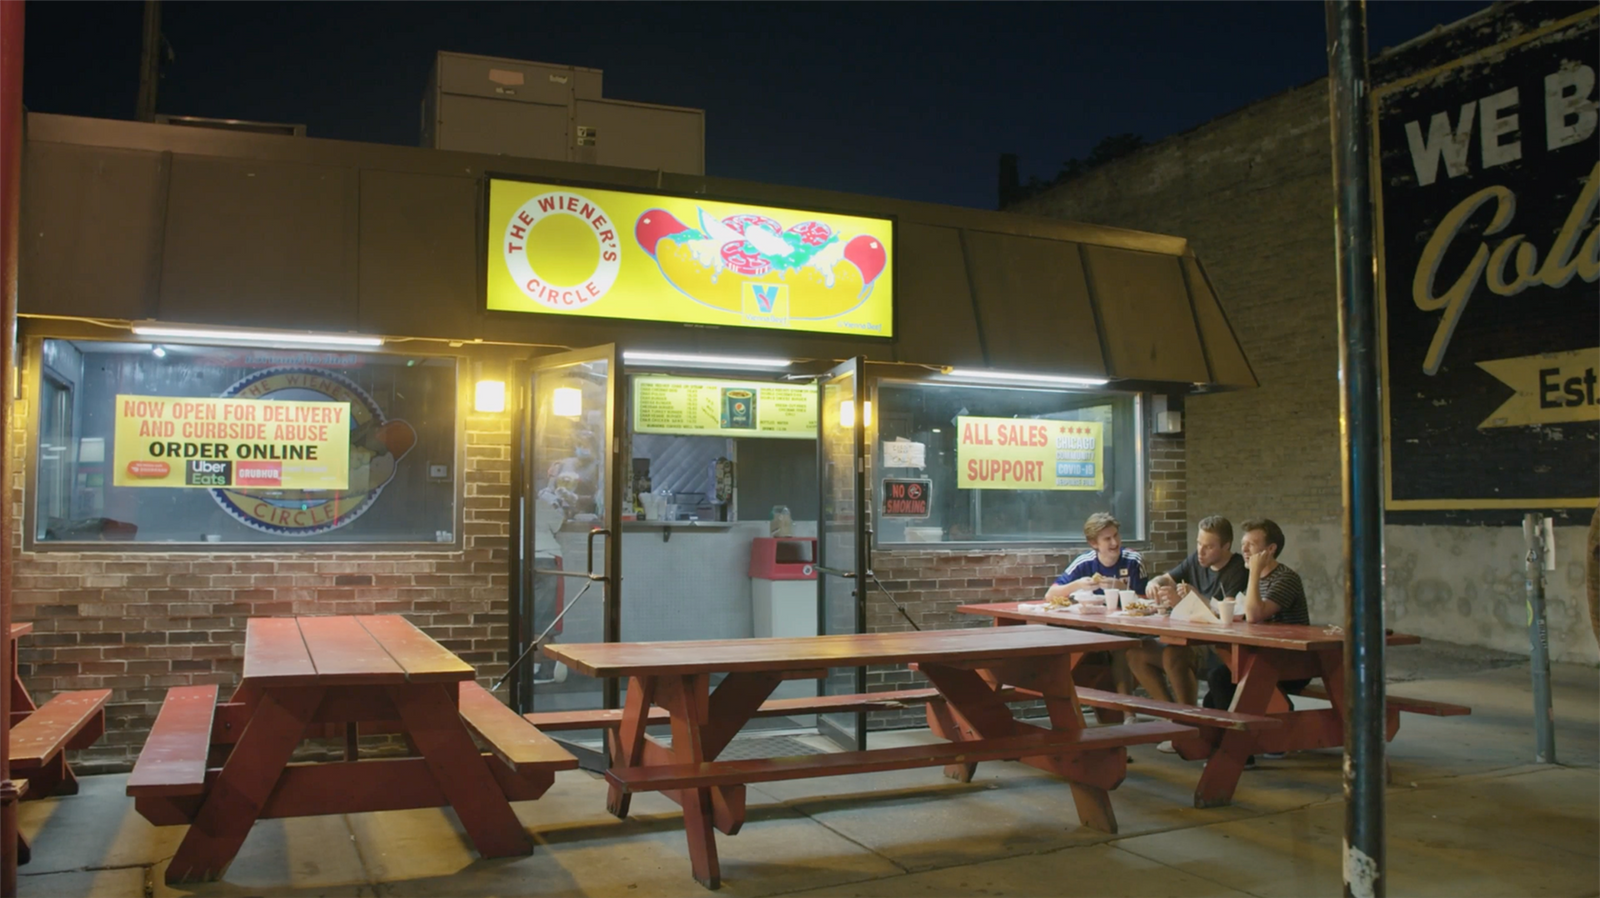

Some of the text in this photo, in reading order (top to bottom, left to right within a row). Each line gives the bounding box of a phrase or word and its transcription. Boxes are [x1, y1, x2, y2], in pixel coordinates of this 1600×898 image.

[1405, 87, 1522, 187] WE
[508, 195, 617, 262] THE WIENER'S
[525, 278, 600, 305] CIRCLE
[124, 401, 343, 423] NOW OPEN FOR DELIVERY
[139, 420, 328, 441] AND CURBSIDE ABUSE
[962, 423, 1048, 448] ALL SALES
[149, 441, 318, 460] ORDER ONLINE
[1056, 437, 1095, 450] CHICAGO
[192, 460, 226, 473] Uber
[239, 468, 280, 479] GRUBHUB
[967, 459, 1044, 482] SUPPORT
[1058, 464, 1094, 475] COVID-19
[192, 473, 226, 485] Eats
[892, 484, 905, 498] NO
[254, 503, 334, 526] CIRCLE
[887, 500, 926, 513] SMOKING
